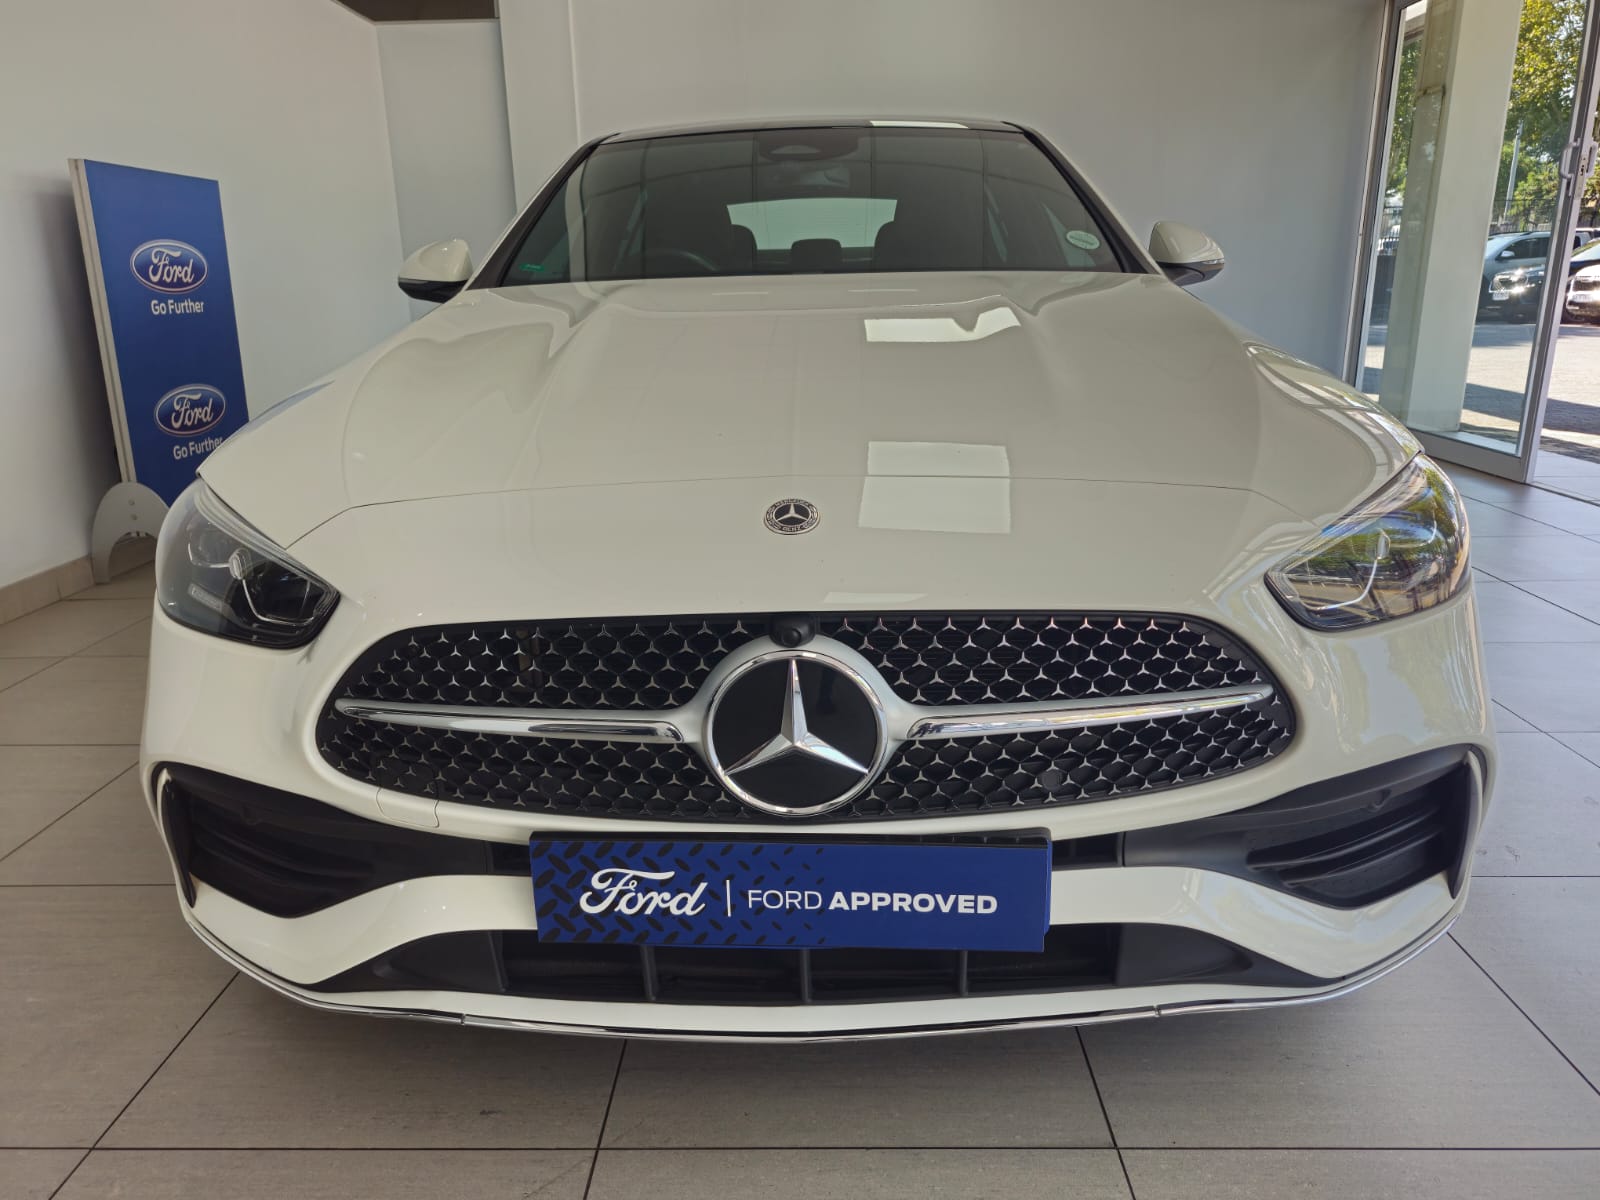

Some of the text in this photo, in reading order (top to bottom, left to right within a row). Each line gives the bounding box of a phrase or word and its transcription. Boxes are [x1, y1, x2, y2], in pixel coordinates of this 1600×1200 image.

[149, 248, 194, 283] Ford
[151, 299, 204, 315] Go Further
[171, 393, 213, 429] Ford
[173, 445, 188, 460] Go
[579, 867, 708, 917] Ford
[747, 889, 998, 914] FORD APPROVED
